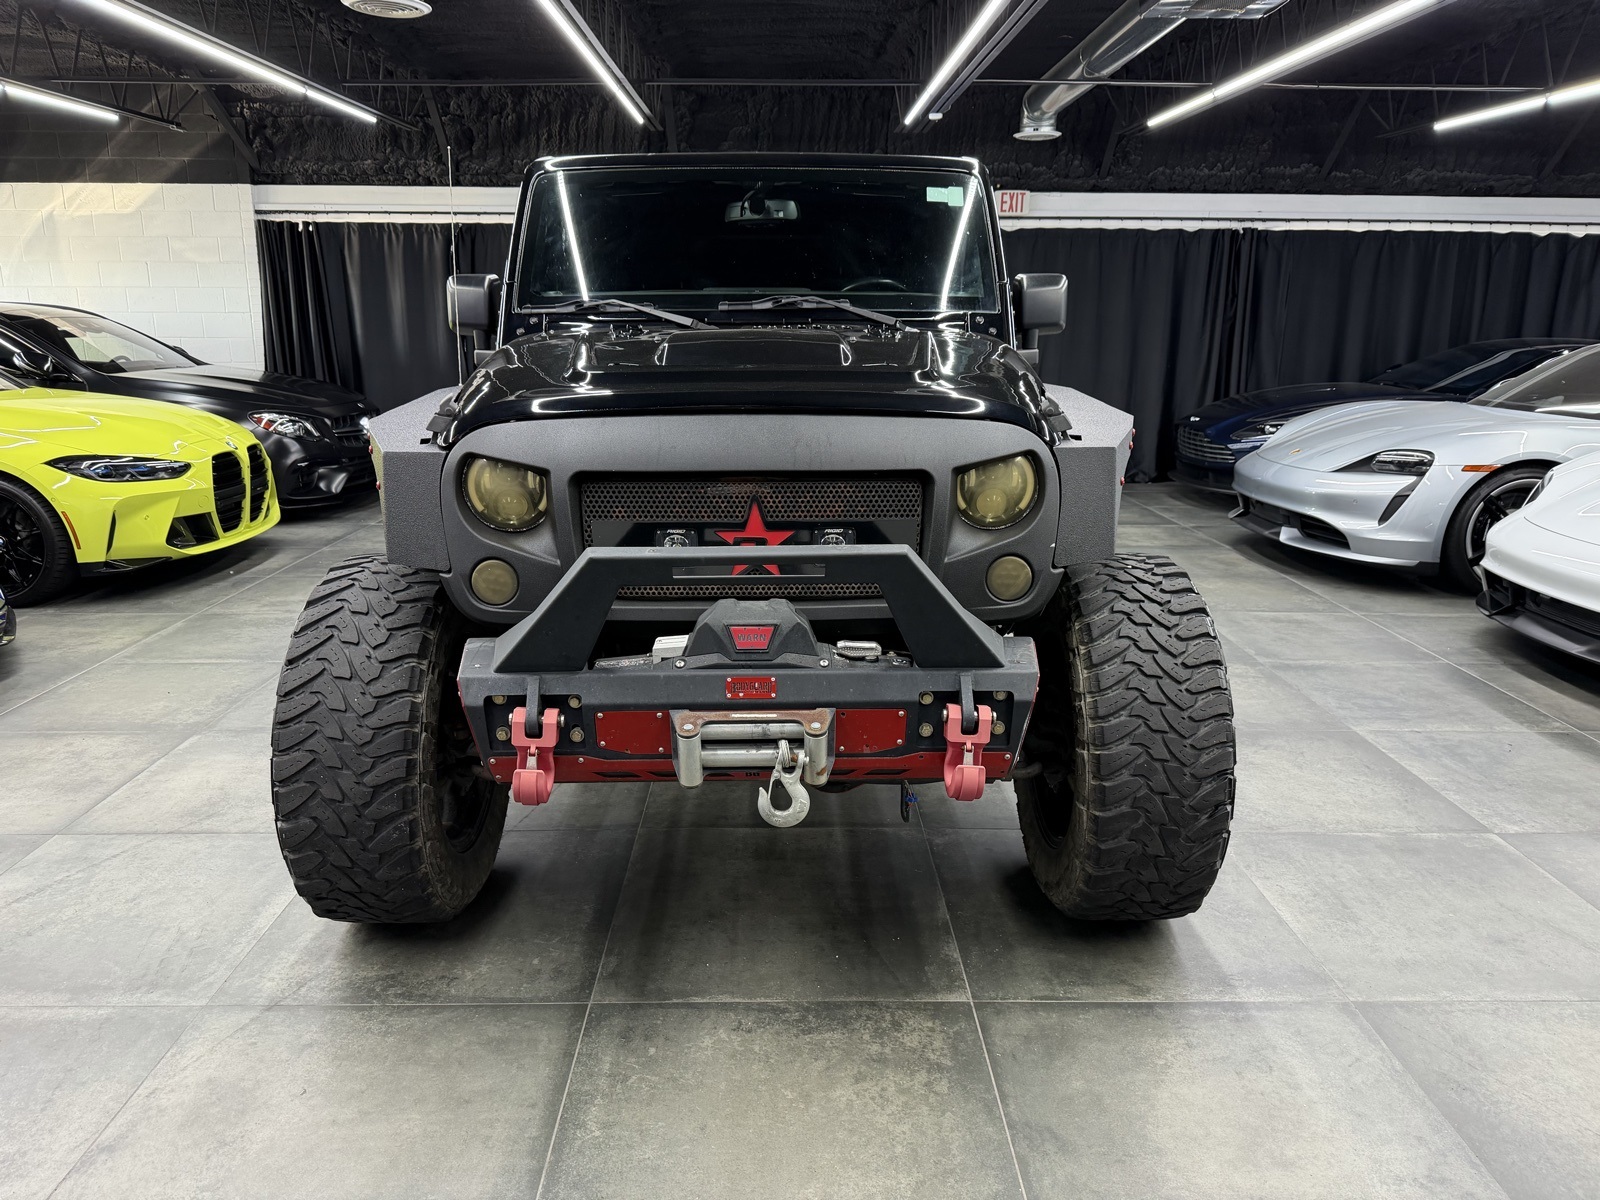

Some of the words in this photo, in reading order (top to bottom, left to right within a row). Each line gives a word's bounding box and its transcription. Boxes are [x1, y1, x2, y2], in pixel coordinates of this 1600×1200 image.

[1000, 192, 1026, 213] EXIT
[737, 633, 767, 642] WARN
[731, 682, 772, 693] BODYGUARD
